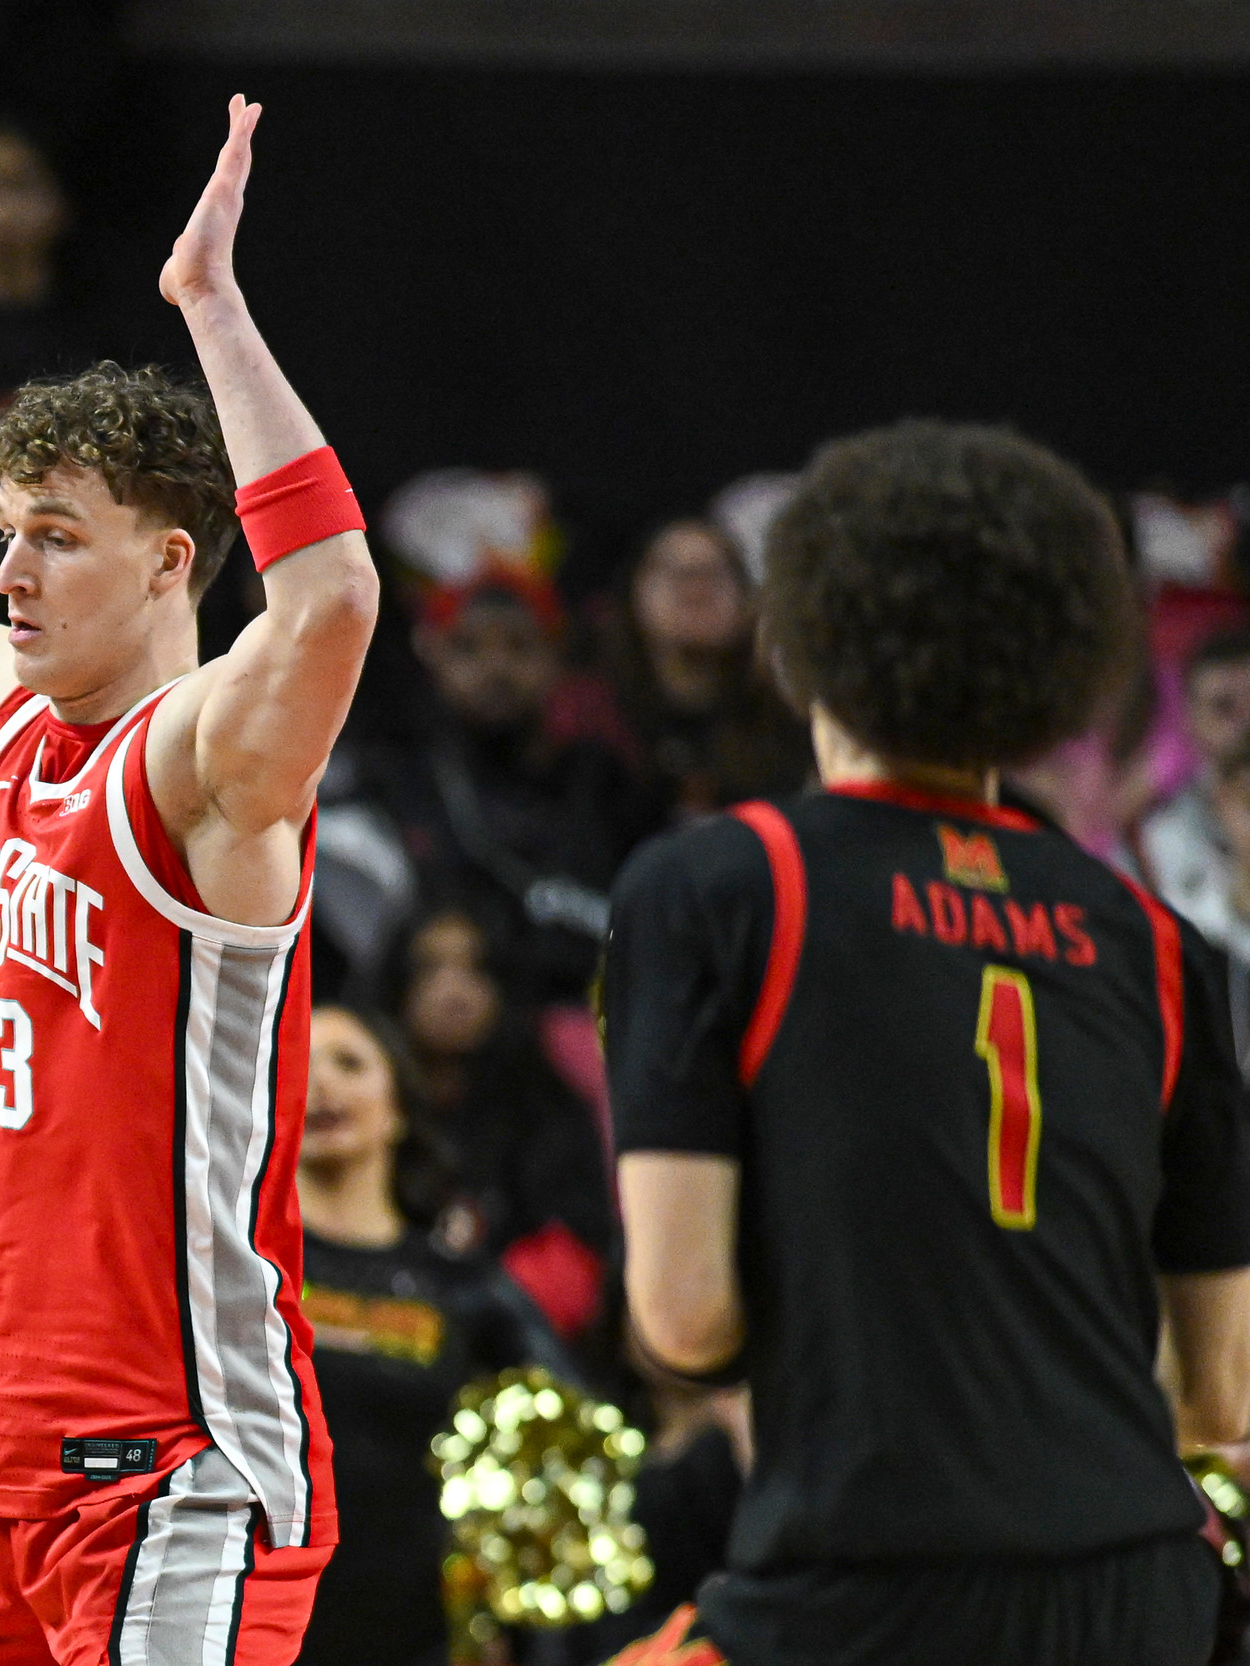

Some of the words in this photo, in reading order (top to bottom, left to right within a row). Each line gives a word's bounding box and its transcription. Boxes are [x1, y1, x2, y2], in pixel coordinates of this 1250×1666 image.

[892, 872, 1097, 967] ADAMS
[974, 964, 1043, 1232] 1
[126, 1449, 142, 1462] 48
